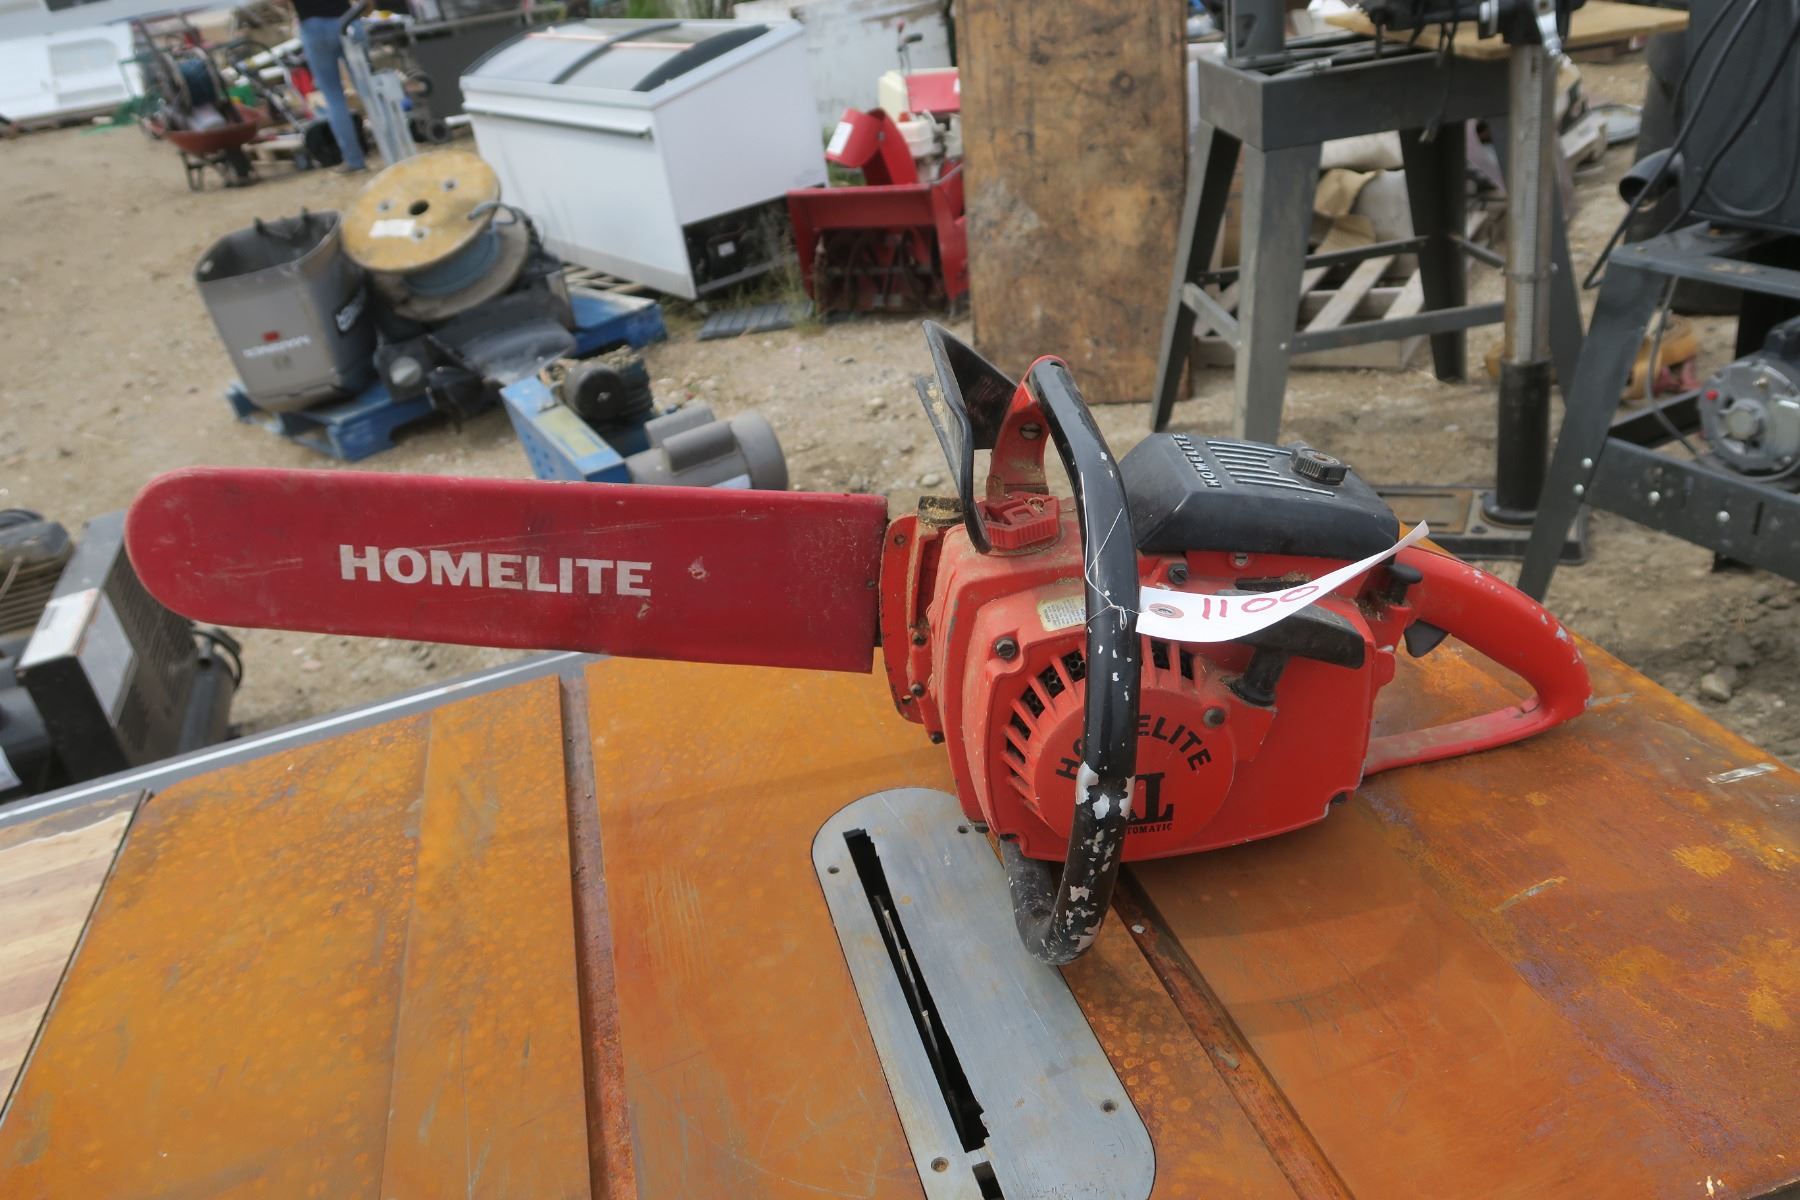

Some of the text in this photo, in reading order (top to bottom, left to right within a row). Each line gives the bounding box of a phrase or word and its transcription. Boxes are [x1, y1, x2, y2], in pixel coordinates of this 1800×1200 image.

[1171, 432, 1222, 488] HOMELITE
[339, 544, 652, 597] HOMELITE
[1202, 585, 1320, 620] 1100
[1055, 714, 1212, 780] HOELITE
[1130, 772, 1175, 823] L
[1127, 822, 1173, 834] TOMATIC
